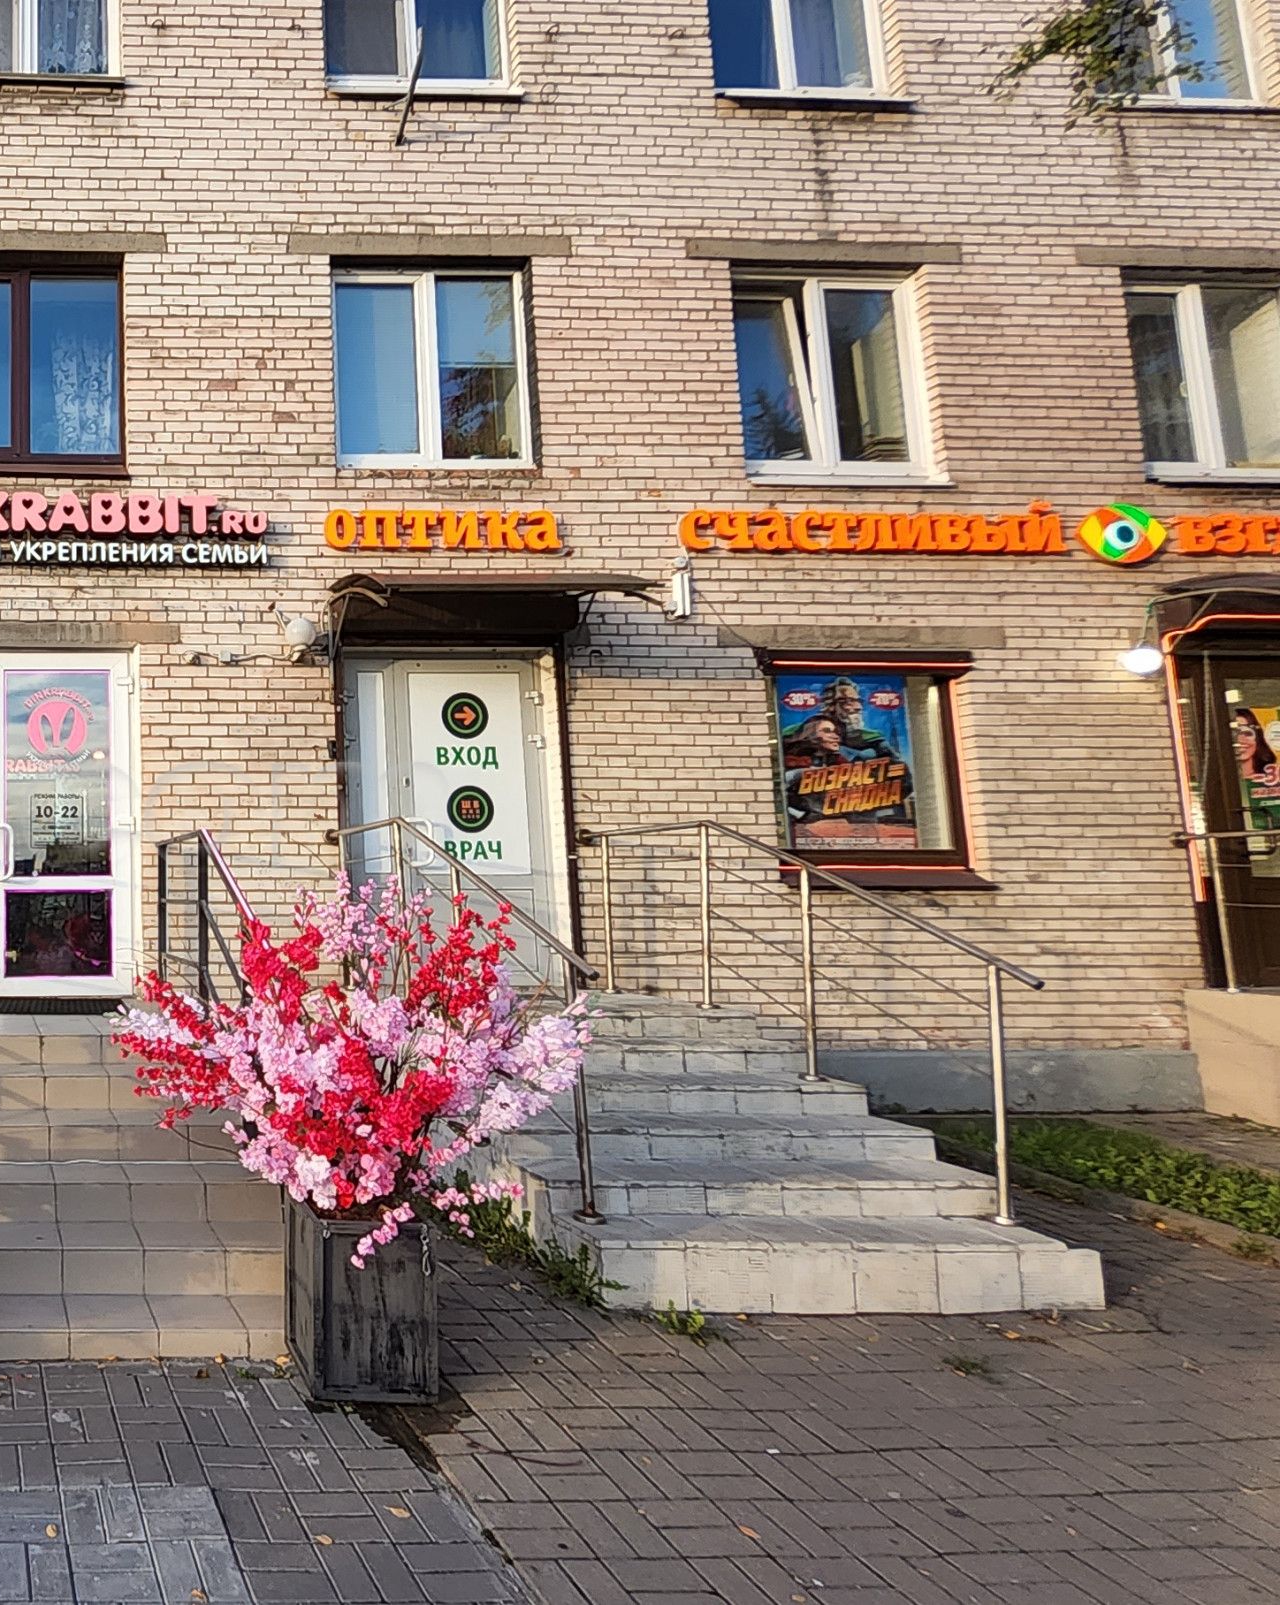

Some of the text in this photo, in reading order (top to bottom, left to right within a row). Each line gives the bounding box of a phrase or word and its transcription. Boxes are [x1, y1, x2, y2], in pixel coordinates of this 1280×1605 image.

[11, 541, 174, 564] УКРЕПЛЕНИЯ
[181, 543, 268, 565] СЕМЬИ
[436, 746, 499, 770] ВХОД
[35, 805, 79, 819] 10-22
[443, 840, 503, 860] ВРАЧ
